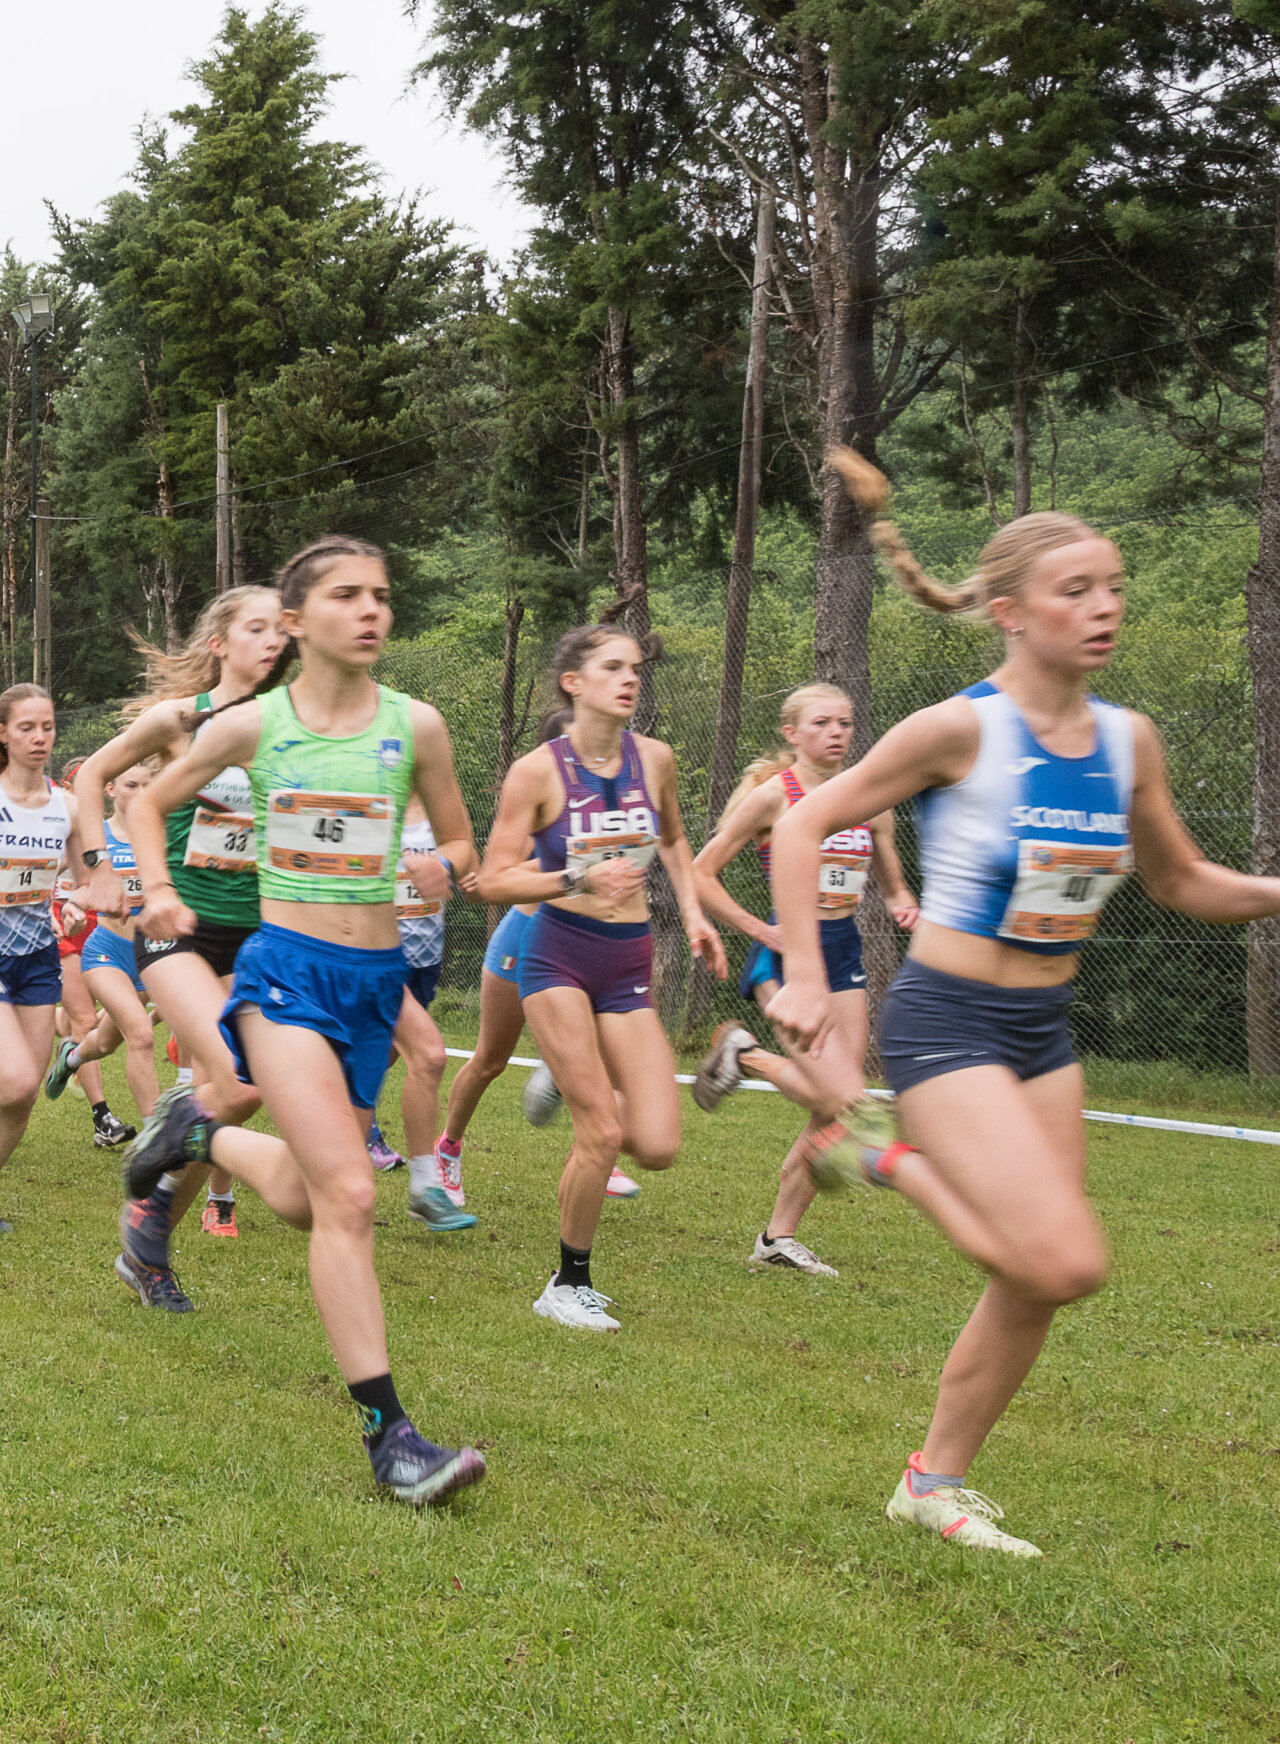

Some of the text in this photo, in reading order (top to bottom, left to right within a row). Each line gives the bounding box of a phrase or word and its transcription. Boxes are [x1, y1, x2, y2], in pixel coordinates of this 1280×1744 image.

[313, 818, 345, 843] 46
[569, 807, 655, 836] USA
[223, 832, 248, 852] 33
[19, 871, 33, 886] 14
[127, 879, 142, 891] 26
